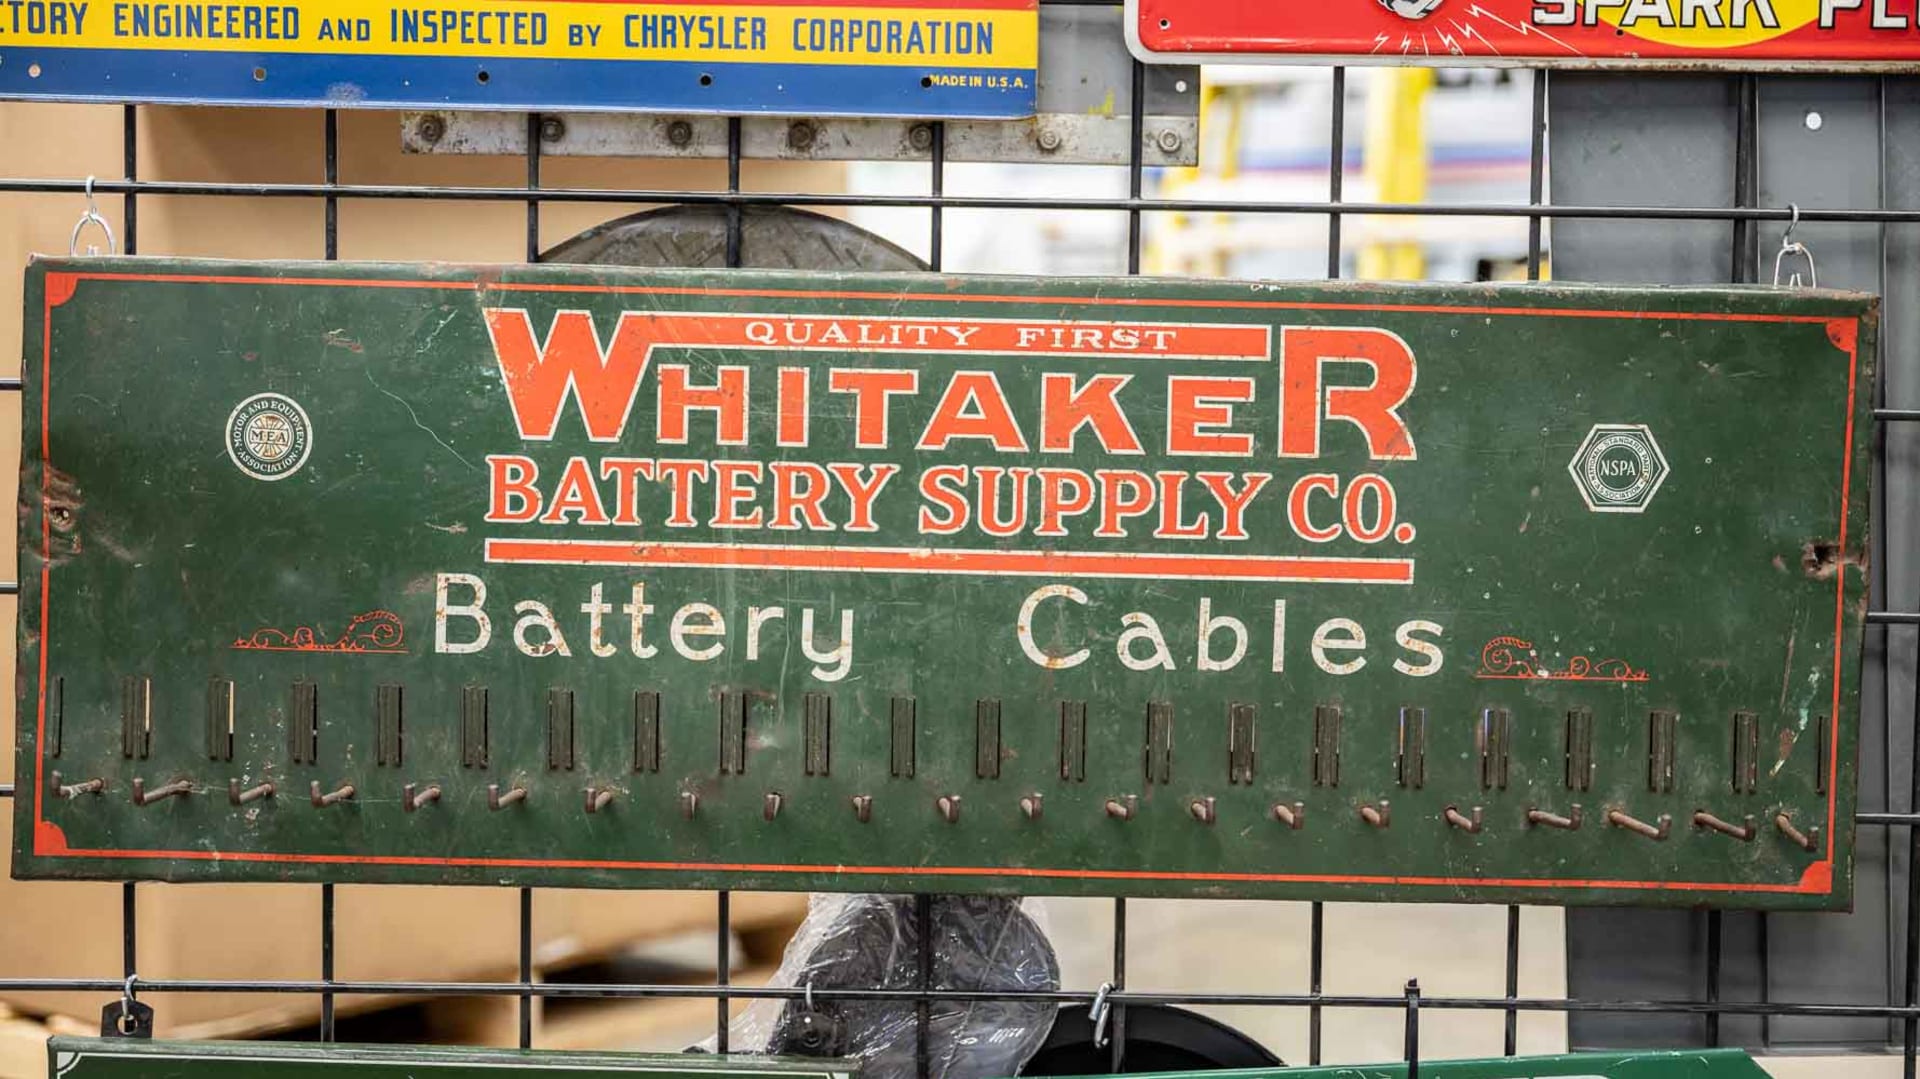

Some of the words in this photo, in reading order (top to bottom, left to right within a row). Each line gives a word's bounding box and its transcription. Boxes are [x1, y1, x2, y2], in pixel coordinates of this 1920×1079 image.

[0, 0, 89, 35] TORY
[113, 3, 300, 41] ENGINEERED
[318, 18, 371, 41] AND
[390, 9, 547, 45] INSPECTED
[568, 24, 602, 46] BY
[624, 14, 767, 50] CHRYSLER
[792, 17, 994, 54] CORPORATION
[929, 74, 967, 86] MADE
[969, 75, 982, 87] IN
[987, 75, 1029, 89] U.S.A.
[744, 320, 981, 347] QUALITY
[1016, 326, 1178, 351] FIRST
[482, 306, 1418, 461] WHITAKER
[233, 412, 249, 448] MOTOR
[248, 401, 269, 416] AND
[270, 400, 305, 451] EQUIPMENT
[250, 430, 288, 441] MEA
[237, 450, 298, 473] ASSOCIATION
[1600, 459, 1636, 476] NSPA
[484, 454, 901, 532] BATTERY
[918, 463, 1274, 541] SUPPLY
[1287, 472, 1417, 544] CO.
[434, 572, 854, 682] Battery
[1017, 583, 1445, 677] Cables
